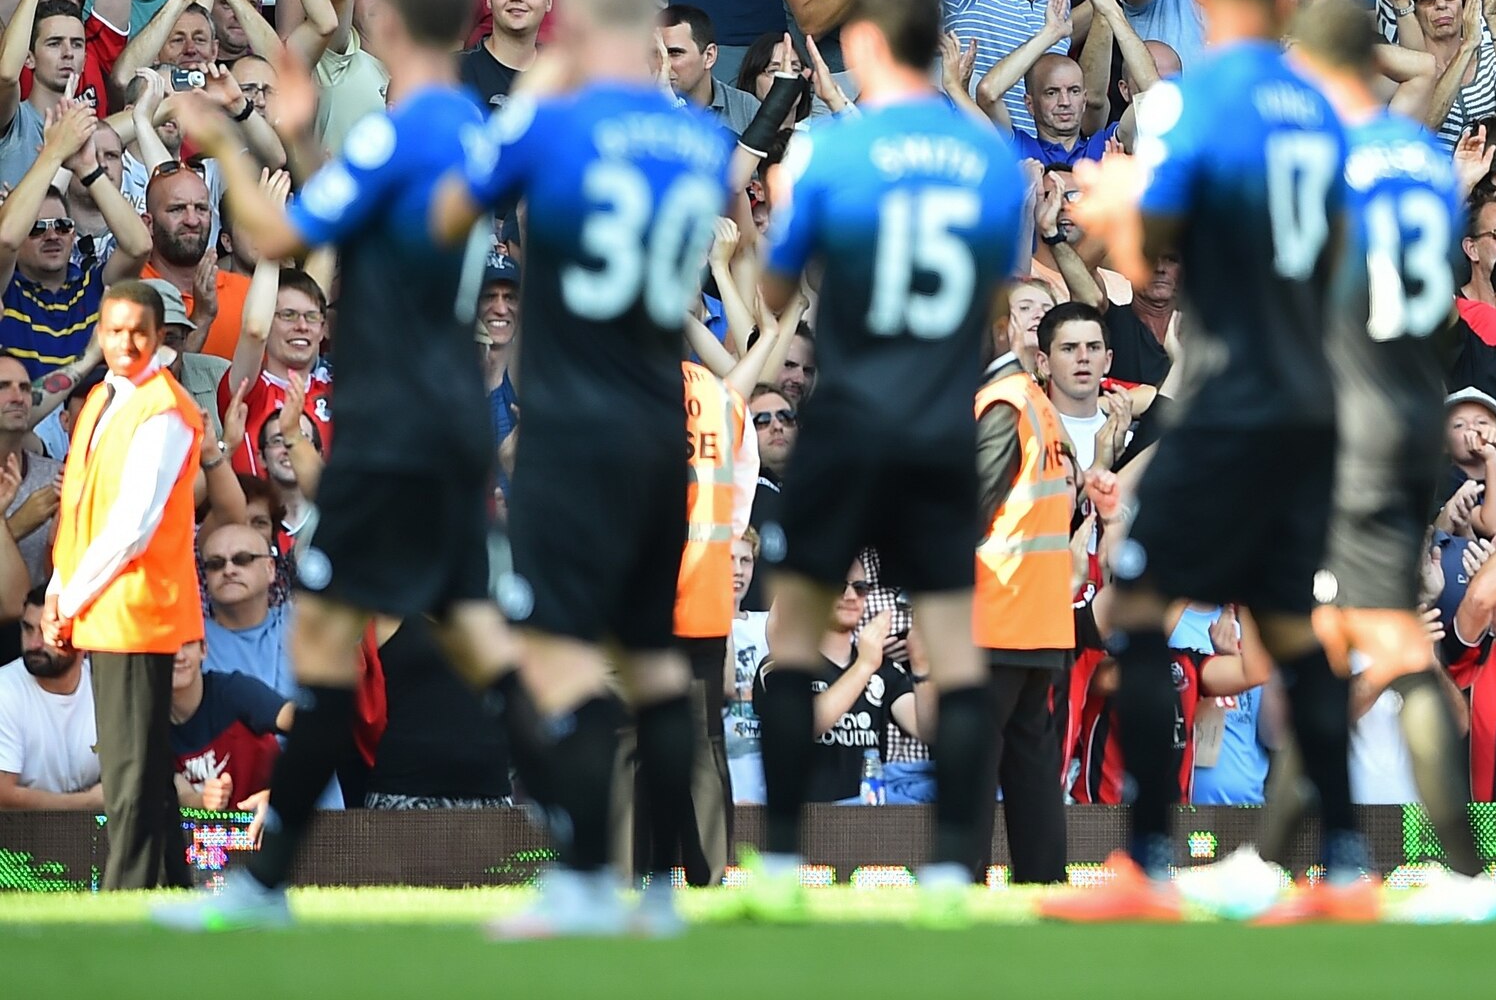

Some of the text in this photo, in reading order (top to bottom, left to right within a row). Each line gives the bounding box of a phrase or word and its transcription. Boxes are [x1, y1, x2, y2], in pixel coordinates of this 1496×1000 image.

[560, 160, 727, 330] 30
[866, 186, 981, 340] 15
[1366, 194, 1453, 342] 13
